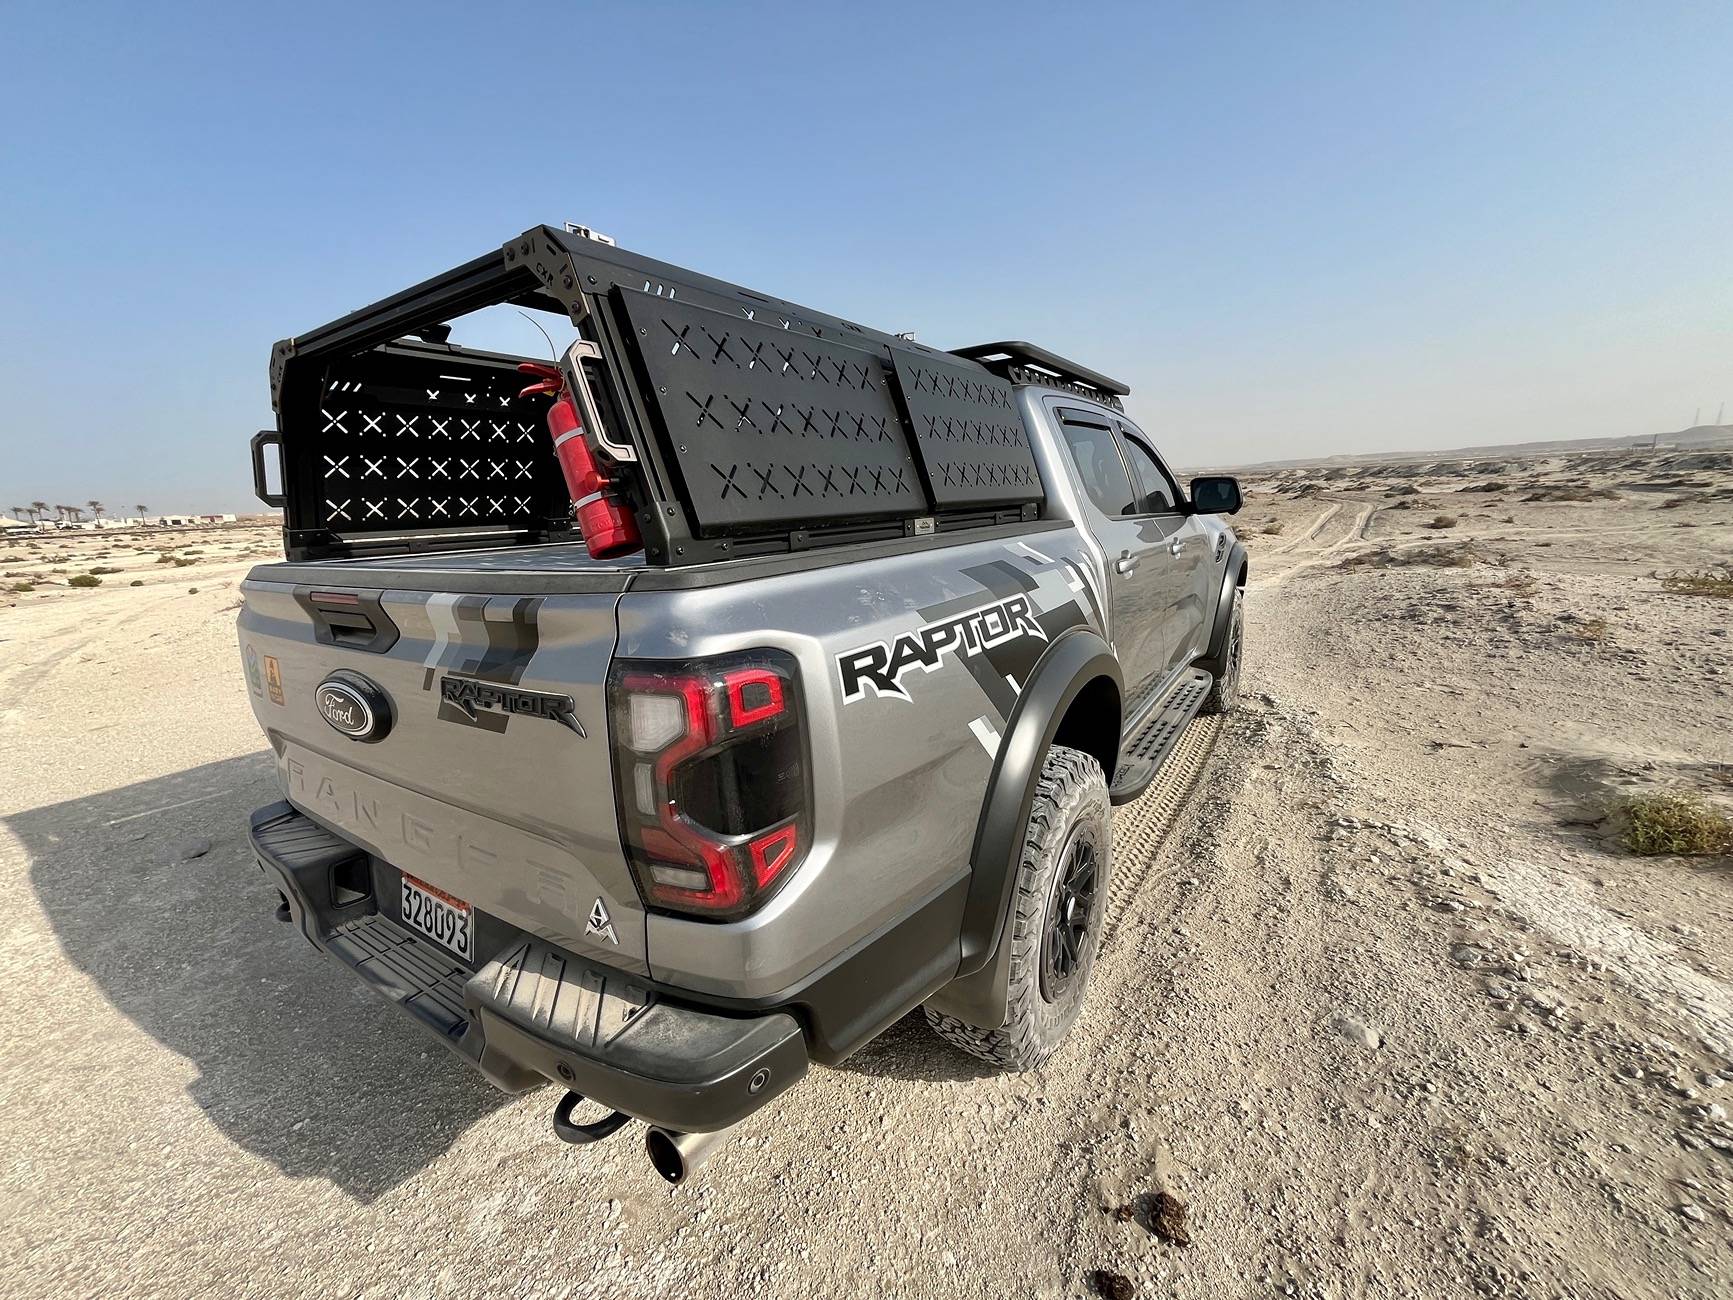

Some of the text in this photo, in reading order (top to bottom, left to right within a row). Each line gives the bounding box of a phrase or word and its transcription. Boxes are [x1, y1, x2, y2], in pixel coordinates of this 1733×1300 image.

[835, 593, 1049, 704] RAPTOR
[324, 693, 355, 726] Ford
[441, 676, 587, 739] RAPTOR
[287, 757, 579, 920] RANGER
[403, 883, 469, 954] 328093
